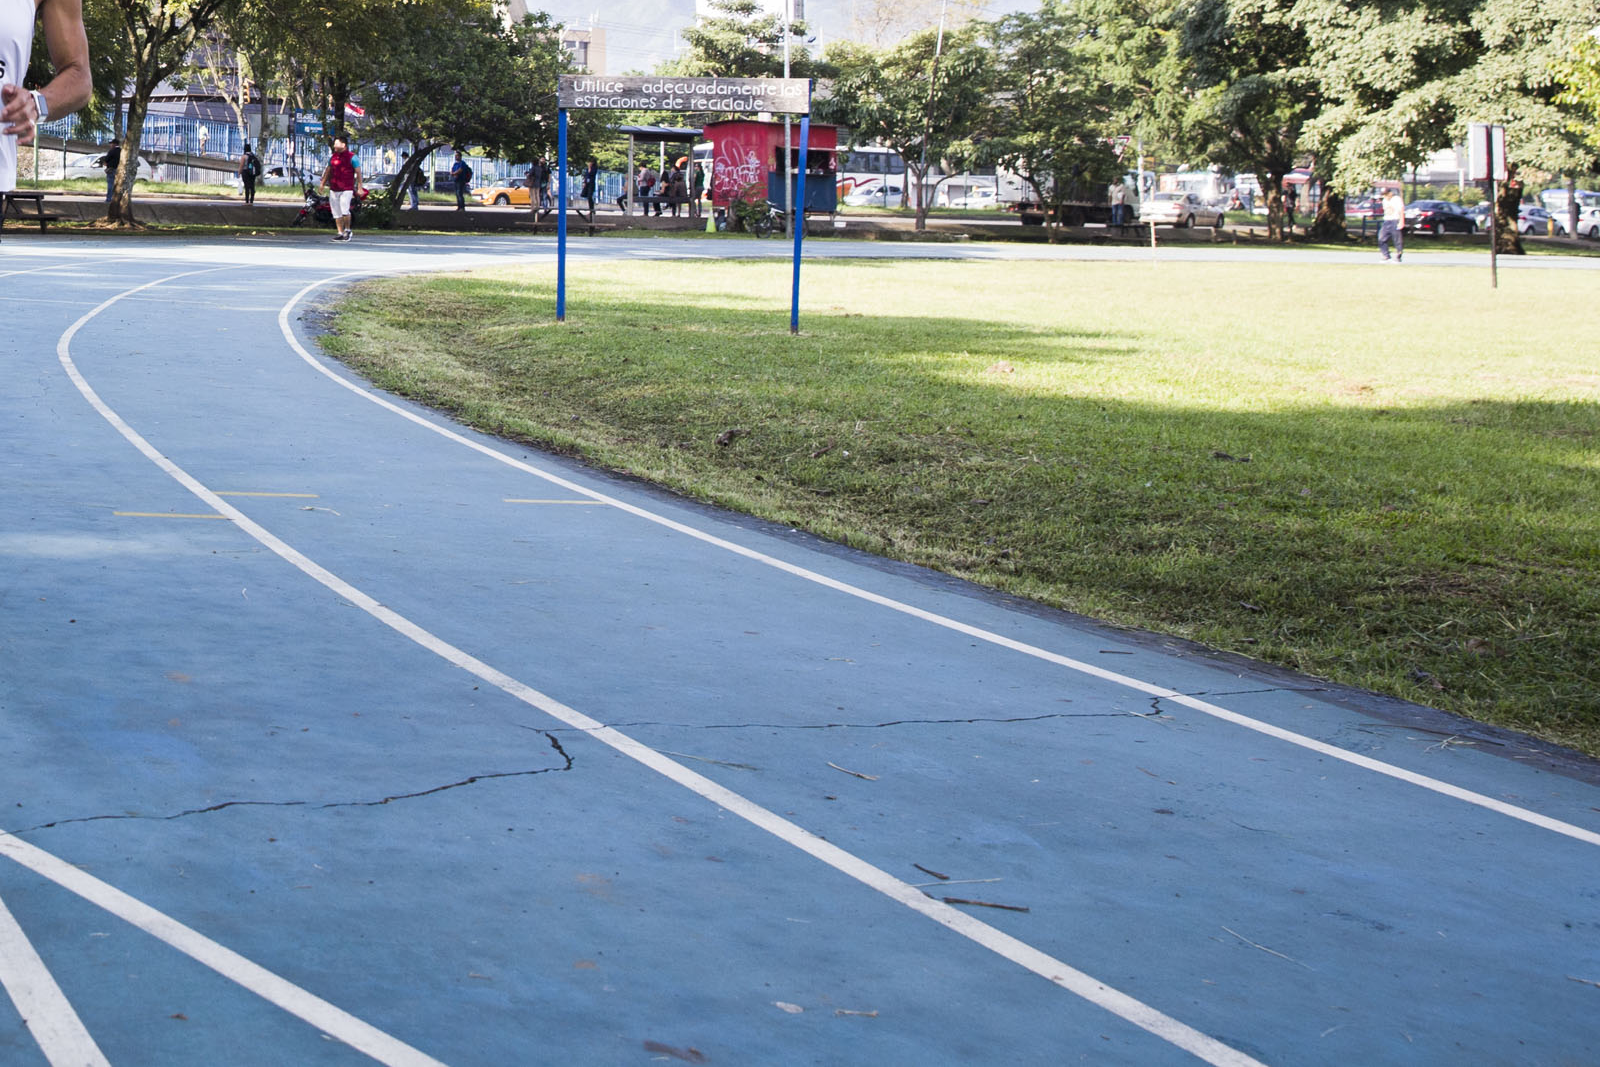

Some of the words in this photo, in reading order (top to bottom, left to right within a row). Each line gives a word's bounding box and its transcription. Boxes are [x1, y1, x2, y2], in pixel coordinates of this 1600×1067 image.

[641, 79, 777, 96] adecuadamente
[781, 82, 802, 96] las
[574, 95, 657, 109] estaciones
[662, 94, 684, 109] de
